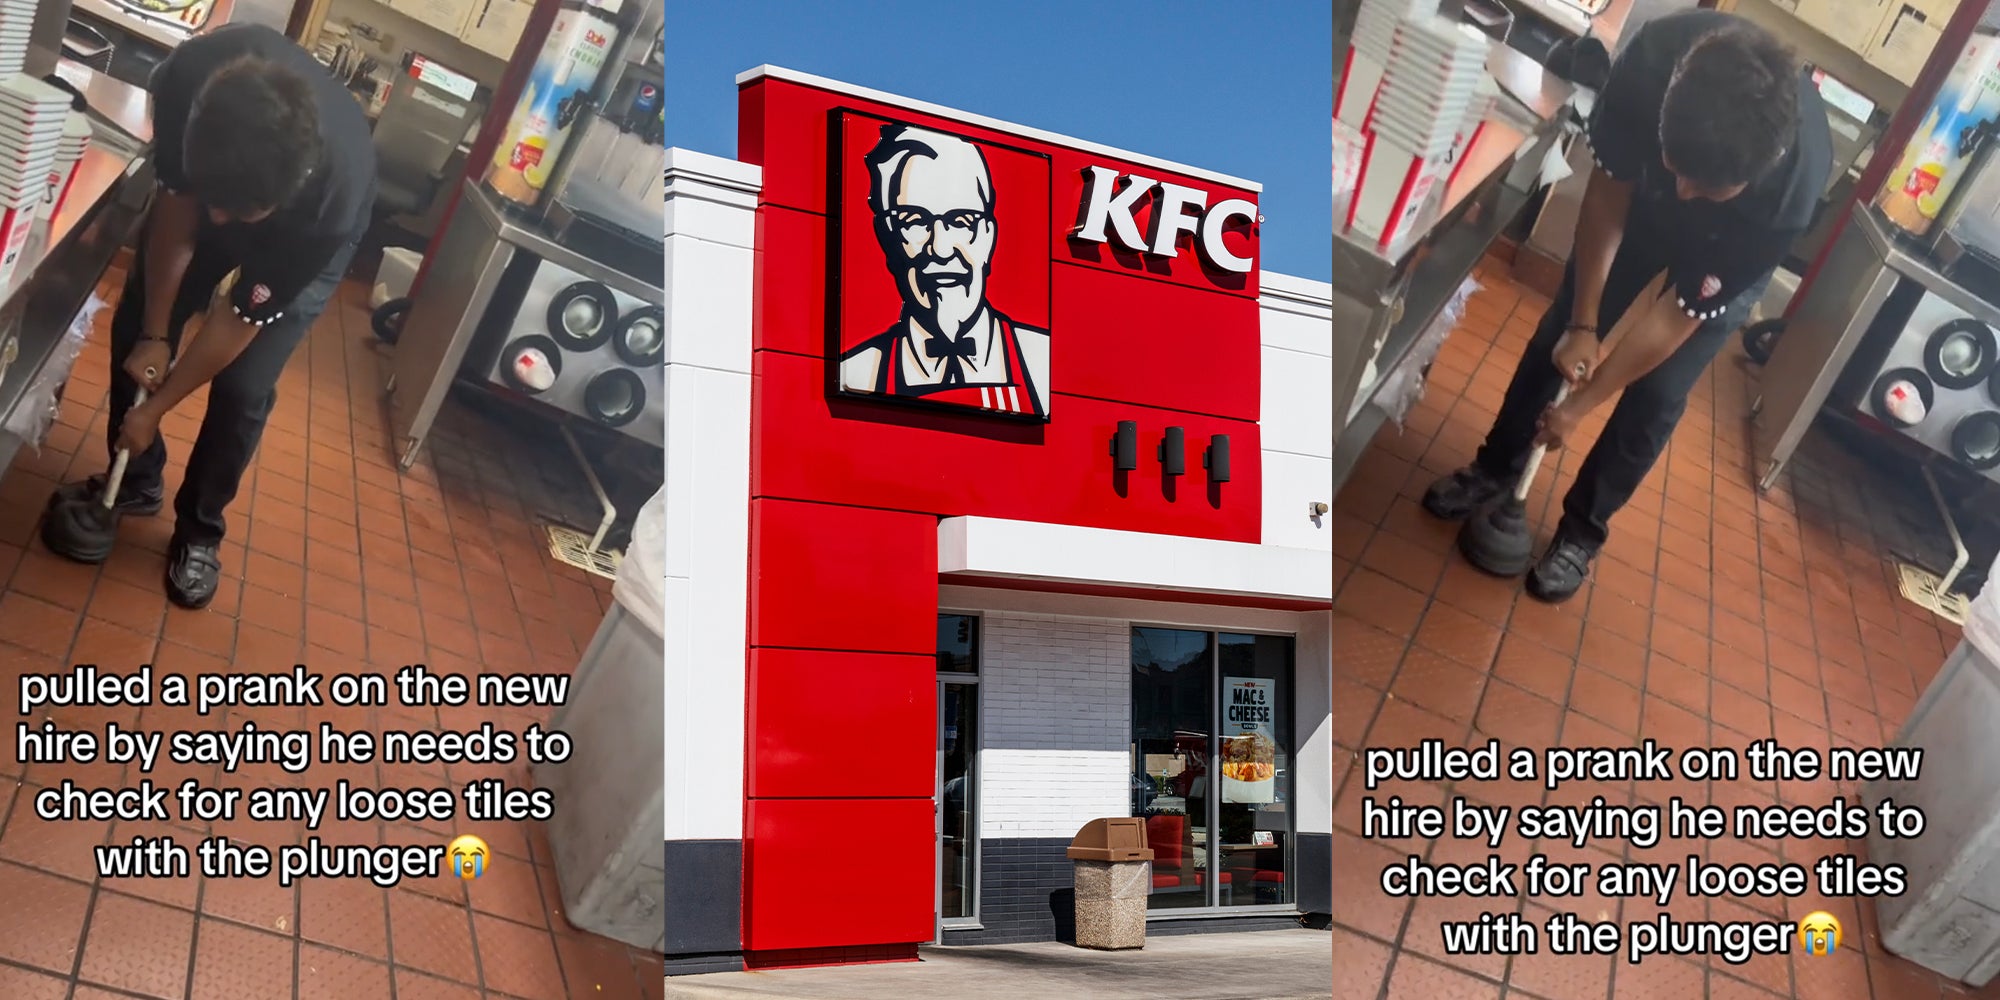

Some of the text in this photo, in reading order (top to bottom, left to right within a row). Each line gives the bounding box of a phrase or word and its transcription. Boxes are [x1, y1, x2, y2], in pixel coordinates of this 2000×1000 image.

[1077, 165, 1258, 272] KFC
[1233, 688, 1257, 705] MAC
[1229, 705, 1270, 722] CHEESE
